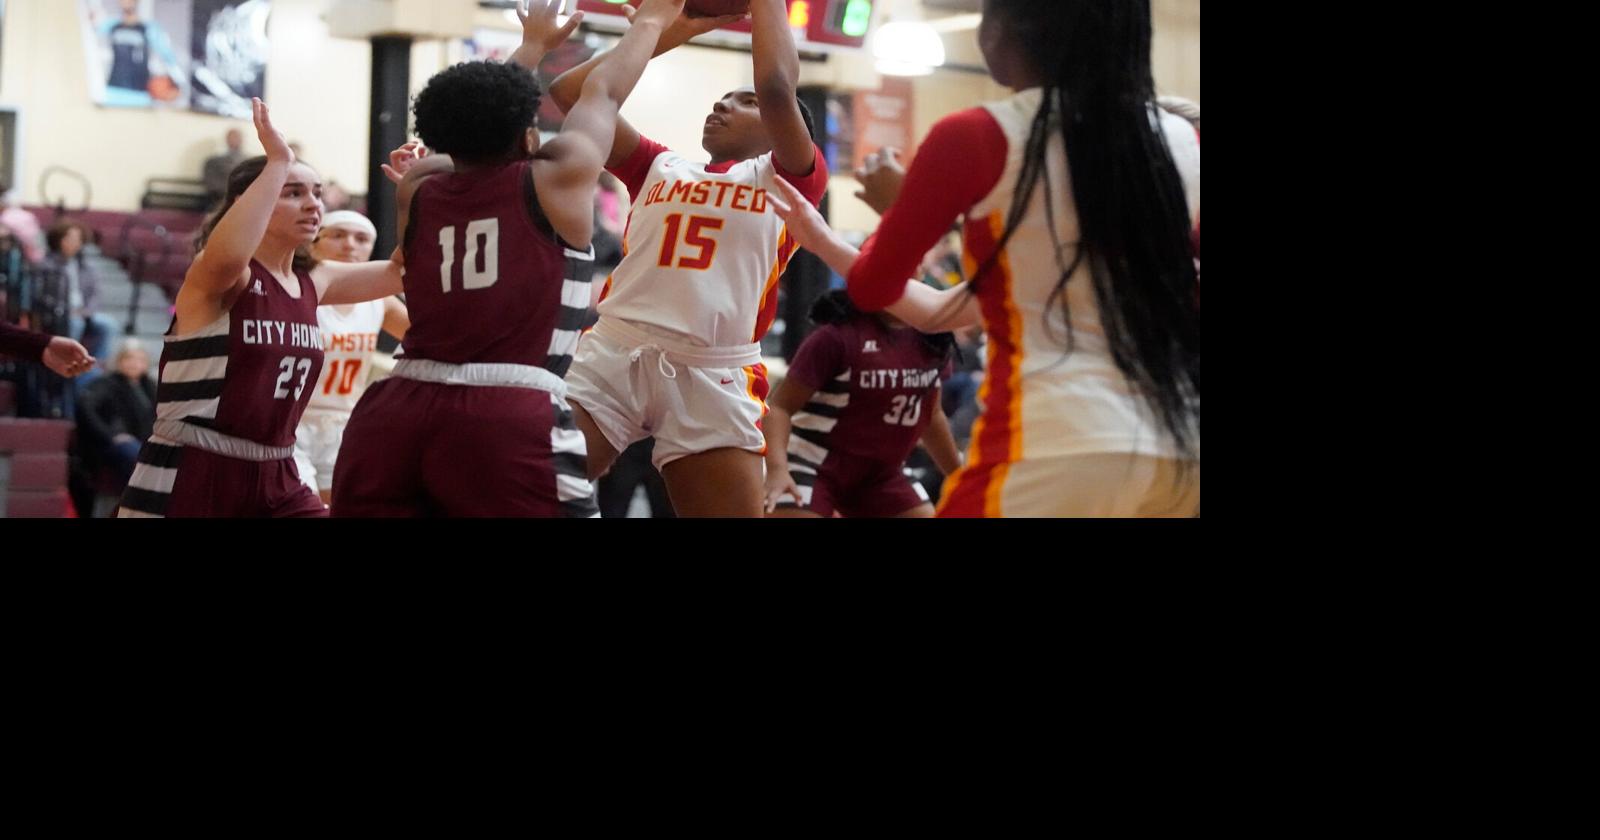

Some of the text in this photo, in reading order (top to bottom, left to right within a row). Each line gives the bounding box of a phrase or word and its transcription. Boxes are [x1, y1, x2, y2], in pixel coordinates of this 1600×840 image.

[644, 180, 769, 213] OLMSTED
[438, 217, 499, 294] 10
[657, 213, 724, 271] 15
[242, 319, 286, 345] CITY
[323, 333, 378, 352] LMSTE
[273, 355, 312, 402] 23
[322, 358, 363, 396] 10
[859, 369, 899, 388] CITY
[883, 394, 922, 427] 30
